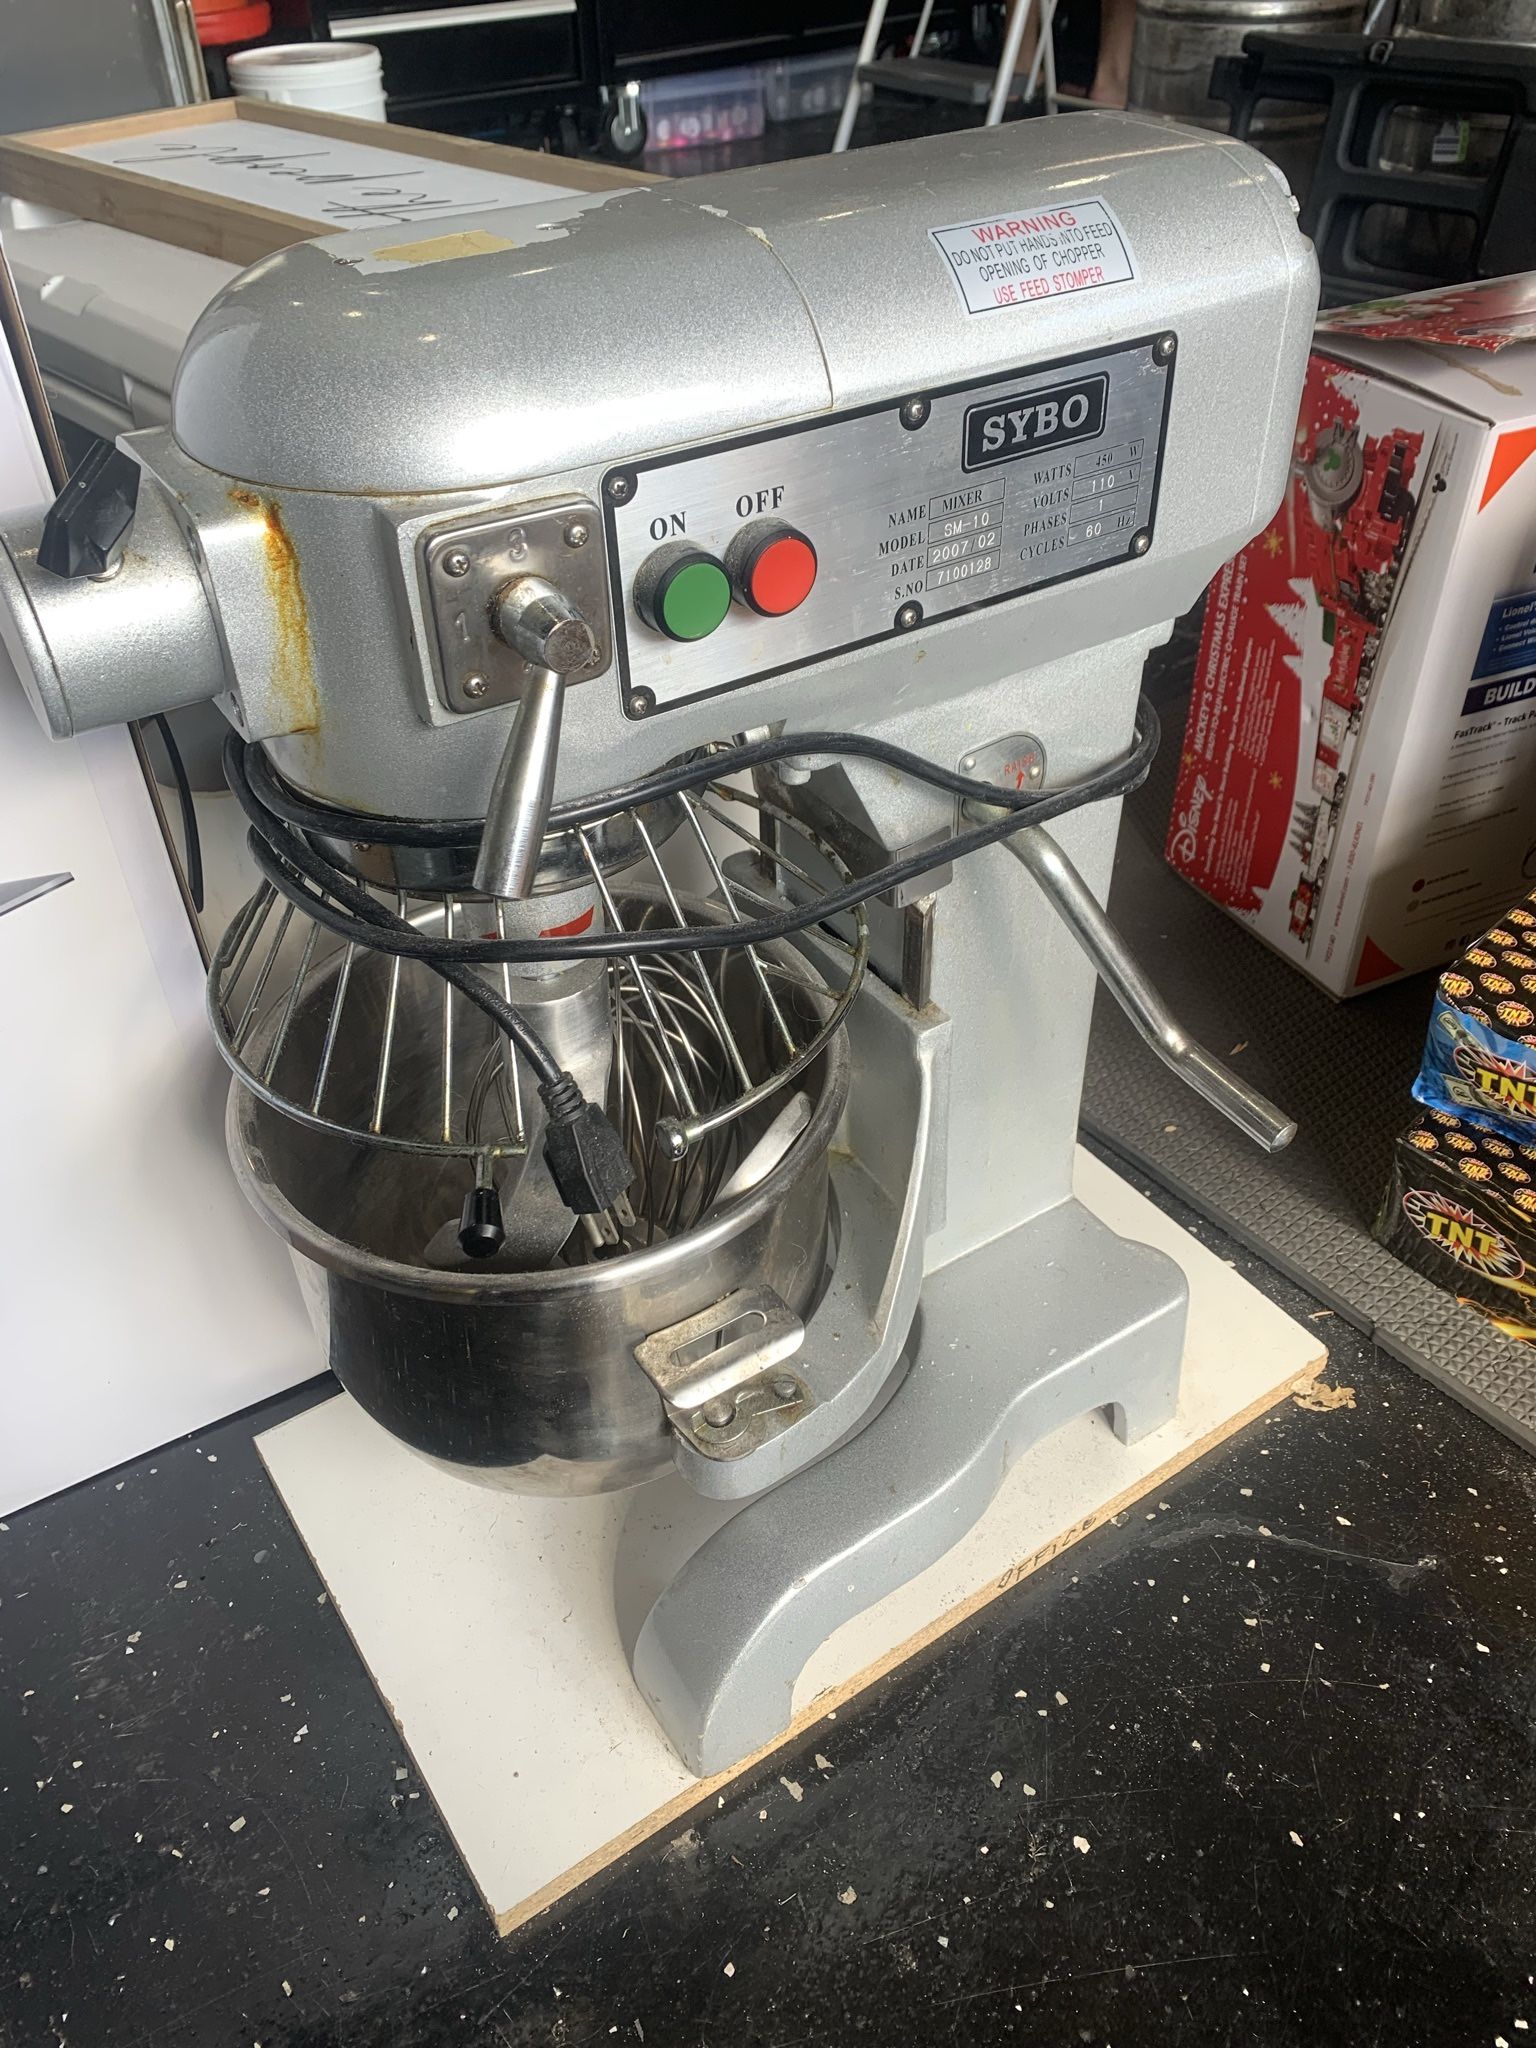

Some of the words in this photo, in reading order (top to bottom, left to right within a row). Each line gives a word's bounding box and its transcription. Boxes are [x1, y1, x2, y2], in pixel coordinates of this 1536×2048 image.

[952, 250, 971, 267] DO
[970, 245, 998, 264] NOT
[998, 240, 1019, 258] PUT
[1019, 234, 1059, 252] HANDS
[1061, 228, 1085, 245] INTO
[1085, 222, 1113, 240] FEED
[972, 211, 1077, 243] WARNING
[979, 259, 1031, 282] OPENING
[1033, 254, 1048, 271] OF
[1052, 243, 1106, 267] CHOPPER
[993, 285, 1018, 305] USE
[1019, 277, 1050, 299] FEED
[1052, 266, 1106, 291] STOMPER
[982, 394, 1089, 453] SYBO
[1033, 463, 1072, 485] WATTS
[1033, 488, 1070, 509] VOLTS
[1091, 474, 1115, 494] 110
[736, 485, 785, 518] OFF
[887, 505, 926, 528] NAME
[942, 489, 982, 513] MIXER
[1023, 512, 1067, 537] PHASES
[1098, 499, 1104, 512] 1
[649, 511, 687, 541] ON
[878, 530, 926, 557] MODEL
[944, 512, 990, 538] SM-10
[1019, 535, 1065, 561] CYCLES
[1085, 522, 1102, 538] 60
[891, 555, 925, 578] DATE
[894, 579, 923, 600] S.NO
[937, 556, 992, 585] 7100128
[1233, 572, 1245, 604] TRAIN
[1193, 690, 1212, 752] MICKEY'S
[1205, 611, 1226, 689] CHRISTMAS
[1425, 1211, 1499, 1256] TNT
